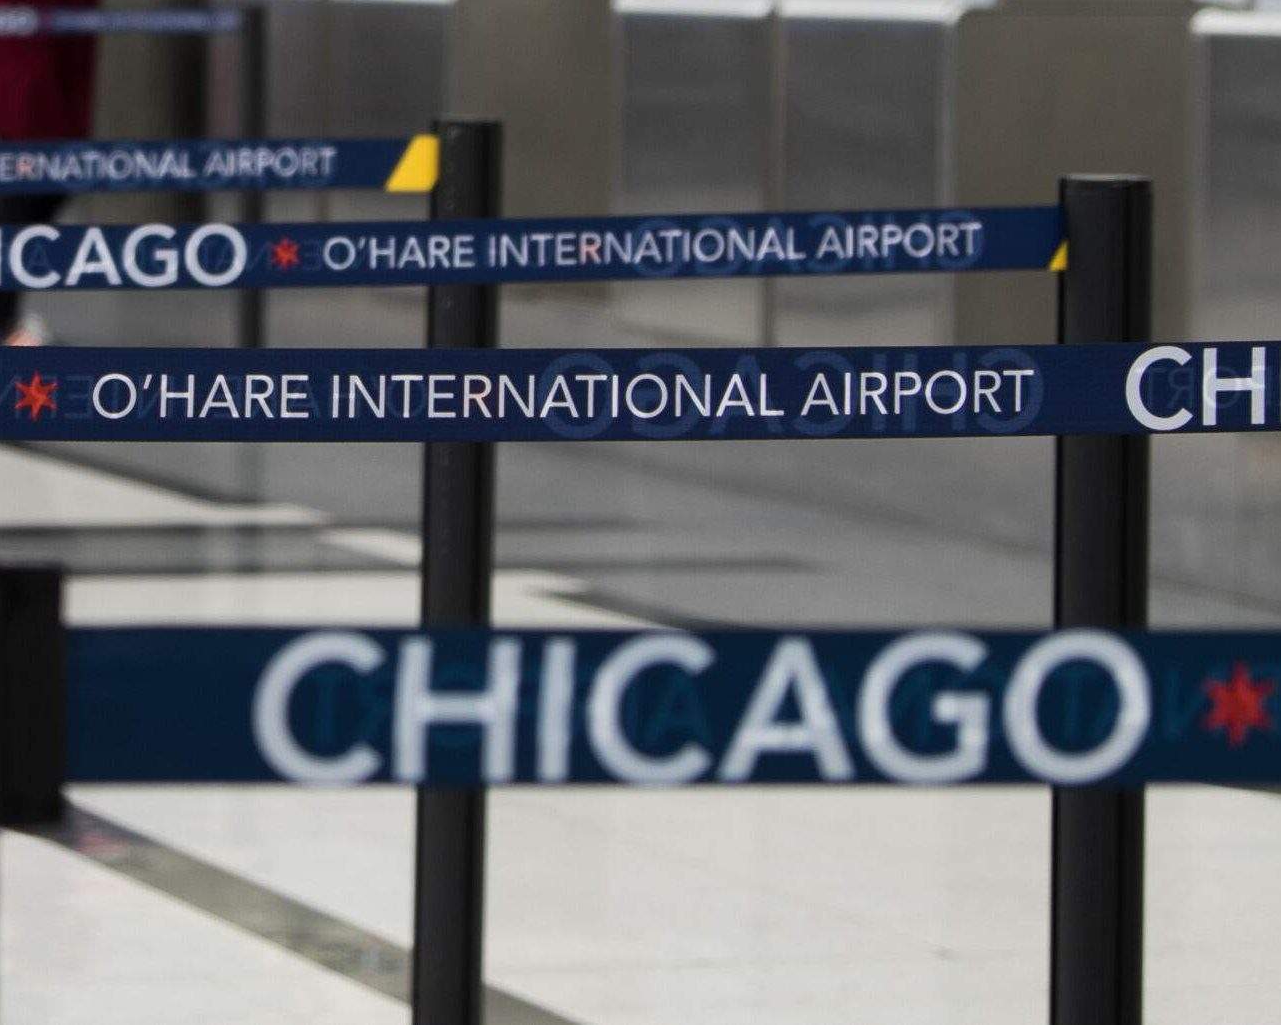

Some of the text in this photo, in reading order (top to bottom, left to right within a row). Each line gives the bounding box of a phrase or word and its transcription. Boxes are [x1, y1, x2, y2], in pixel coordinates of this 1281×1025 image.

[204, 146, 338, 179] AIRPORT
[322, 234, 476, 272] O'HARE
[488, 225, 807, 268] INTERNATIONAL
[817, 221, 985, 260] AIRPORT
[92, 373, 311, 421] O'HARE
[331, 373, 786, 421] INTERNATIONAL
[800, 369, 1036, 417] AIRPORT
[1125, 345, 1267, 431] CH
[252, 630, 1153, 785] CHICAGO
